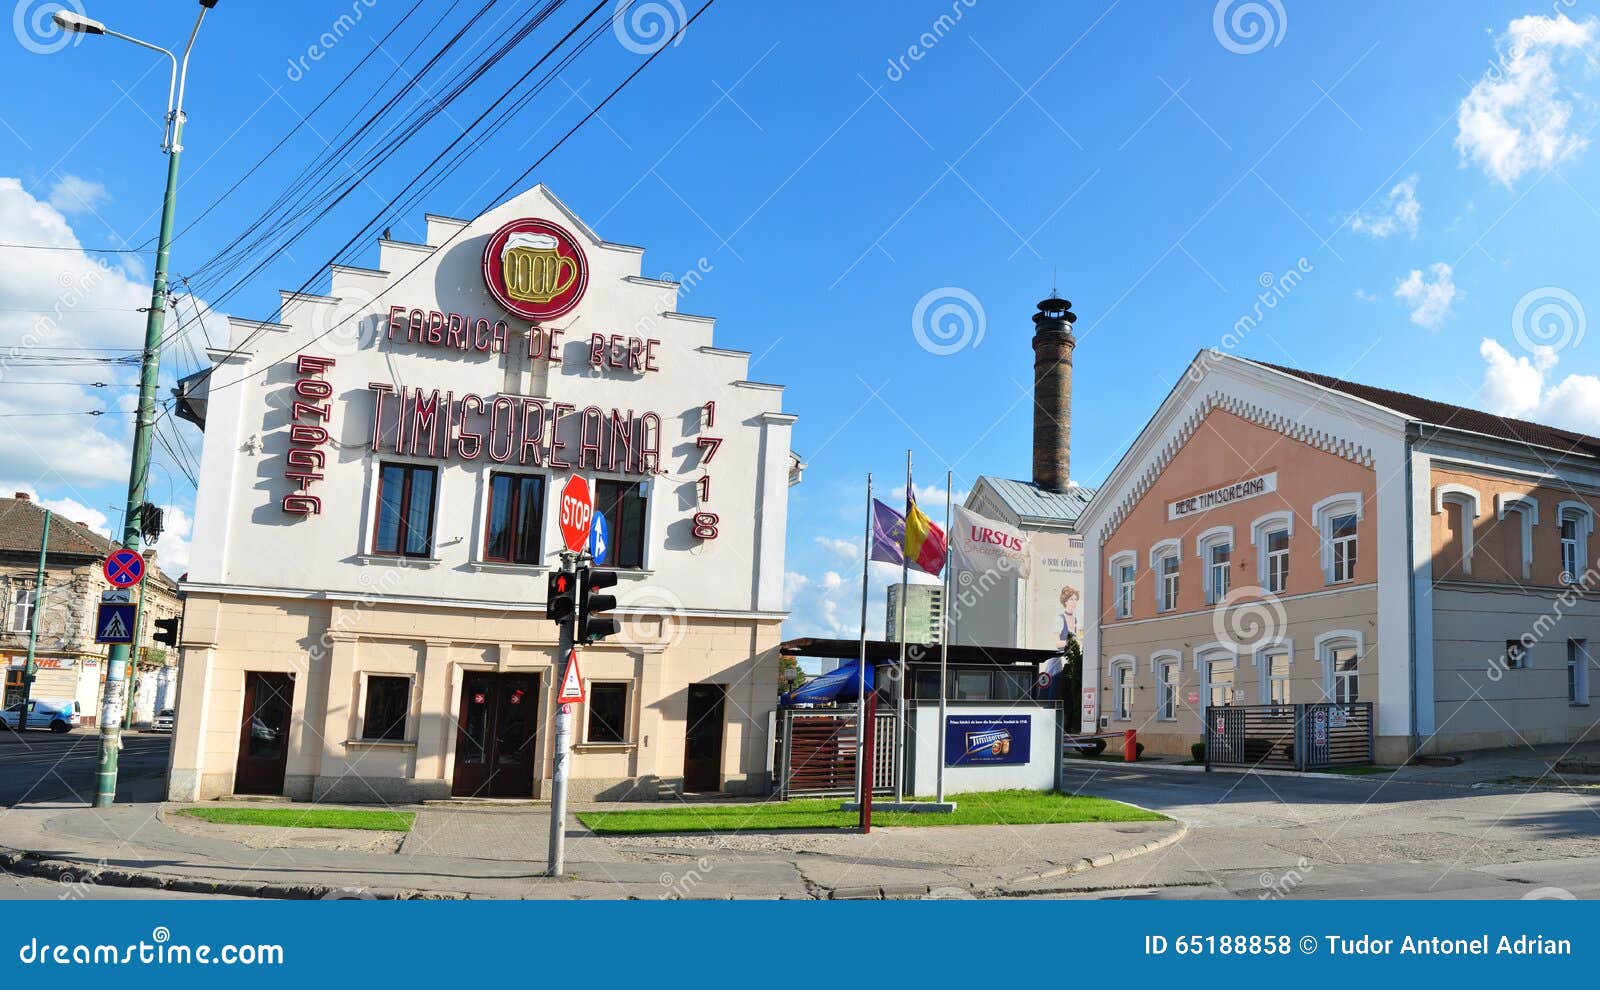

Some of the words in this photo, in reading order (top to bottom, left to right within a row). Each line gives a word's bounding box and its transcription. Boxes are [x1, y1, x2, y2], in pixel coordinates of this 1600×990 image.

[388, 305, 509, 354] FABRICA
[528, 326, 565, 362] DE
[590, 332, 661, 372] BERE
[368, 382, 662, 474] TIMISOREANA
[1198, 478, 1265, 508] TIMISOREANA
[562, 494, 591, 532] STOP
[971, 525, 1023, 552] URSUS
